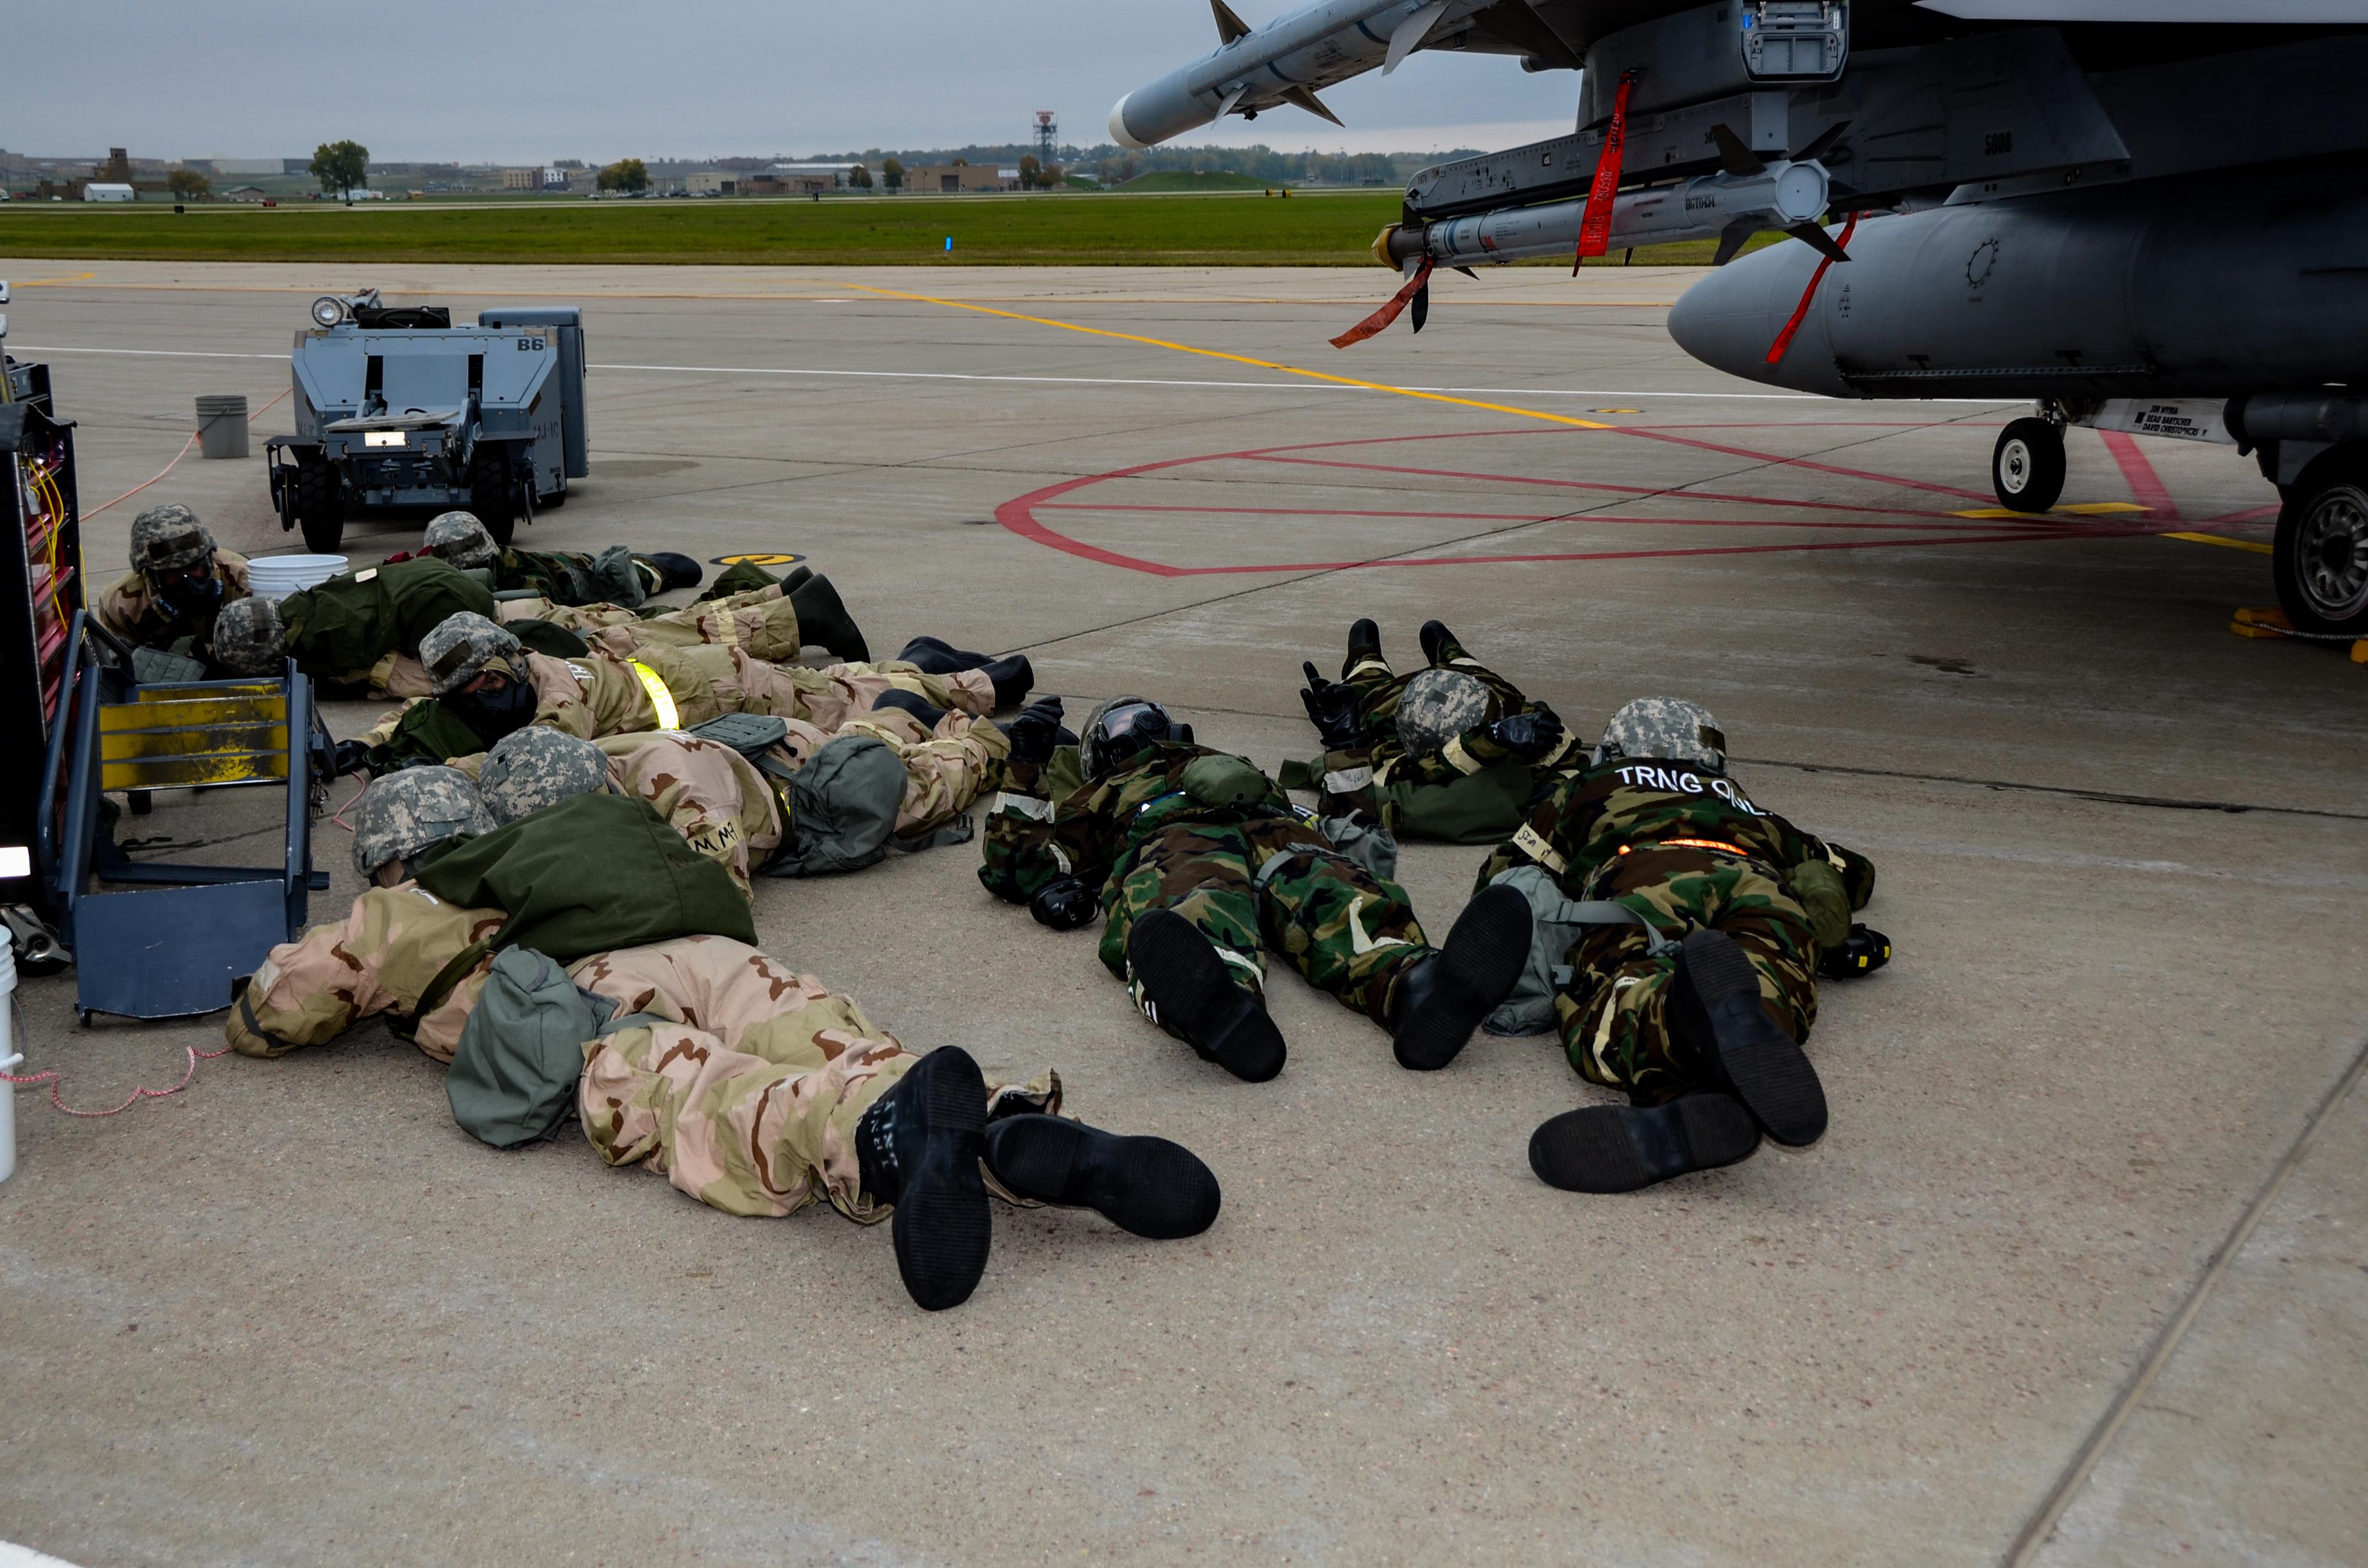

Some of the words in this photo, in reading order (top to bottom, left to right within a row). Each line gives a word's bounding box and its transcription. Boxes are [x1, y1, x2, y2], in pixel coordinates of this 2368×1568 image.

[1984, 131, 2012, 156] 5008
[1587, 215, 1605, 243] FLIGHT
[518, 338, 544, 351] B6
[2142, 423, 2160, 432] DAVID
[2162, 416, 2192, 427] BARTSCHER
[1615, 766, 1703, 793] TRNG
[1711, 780, 1773, 816] ONL
